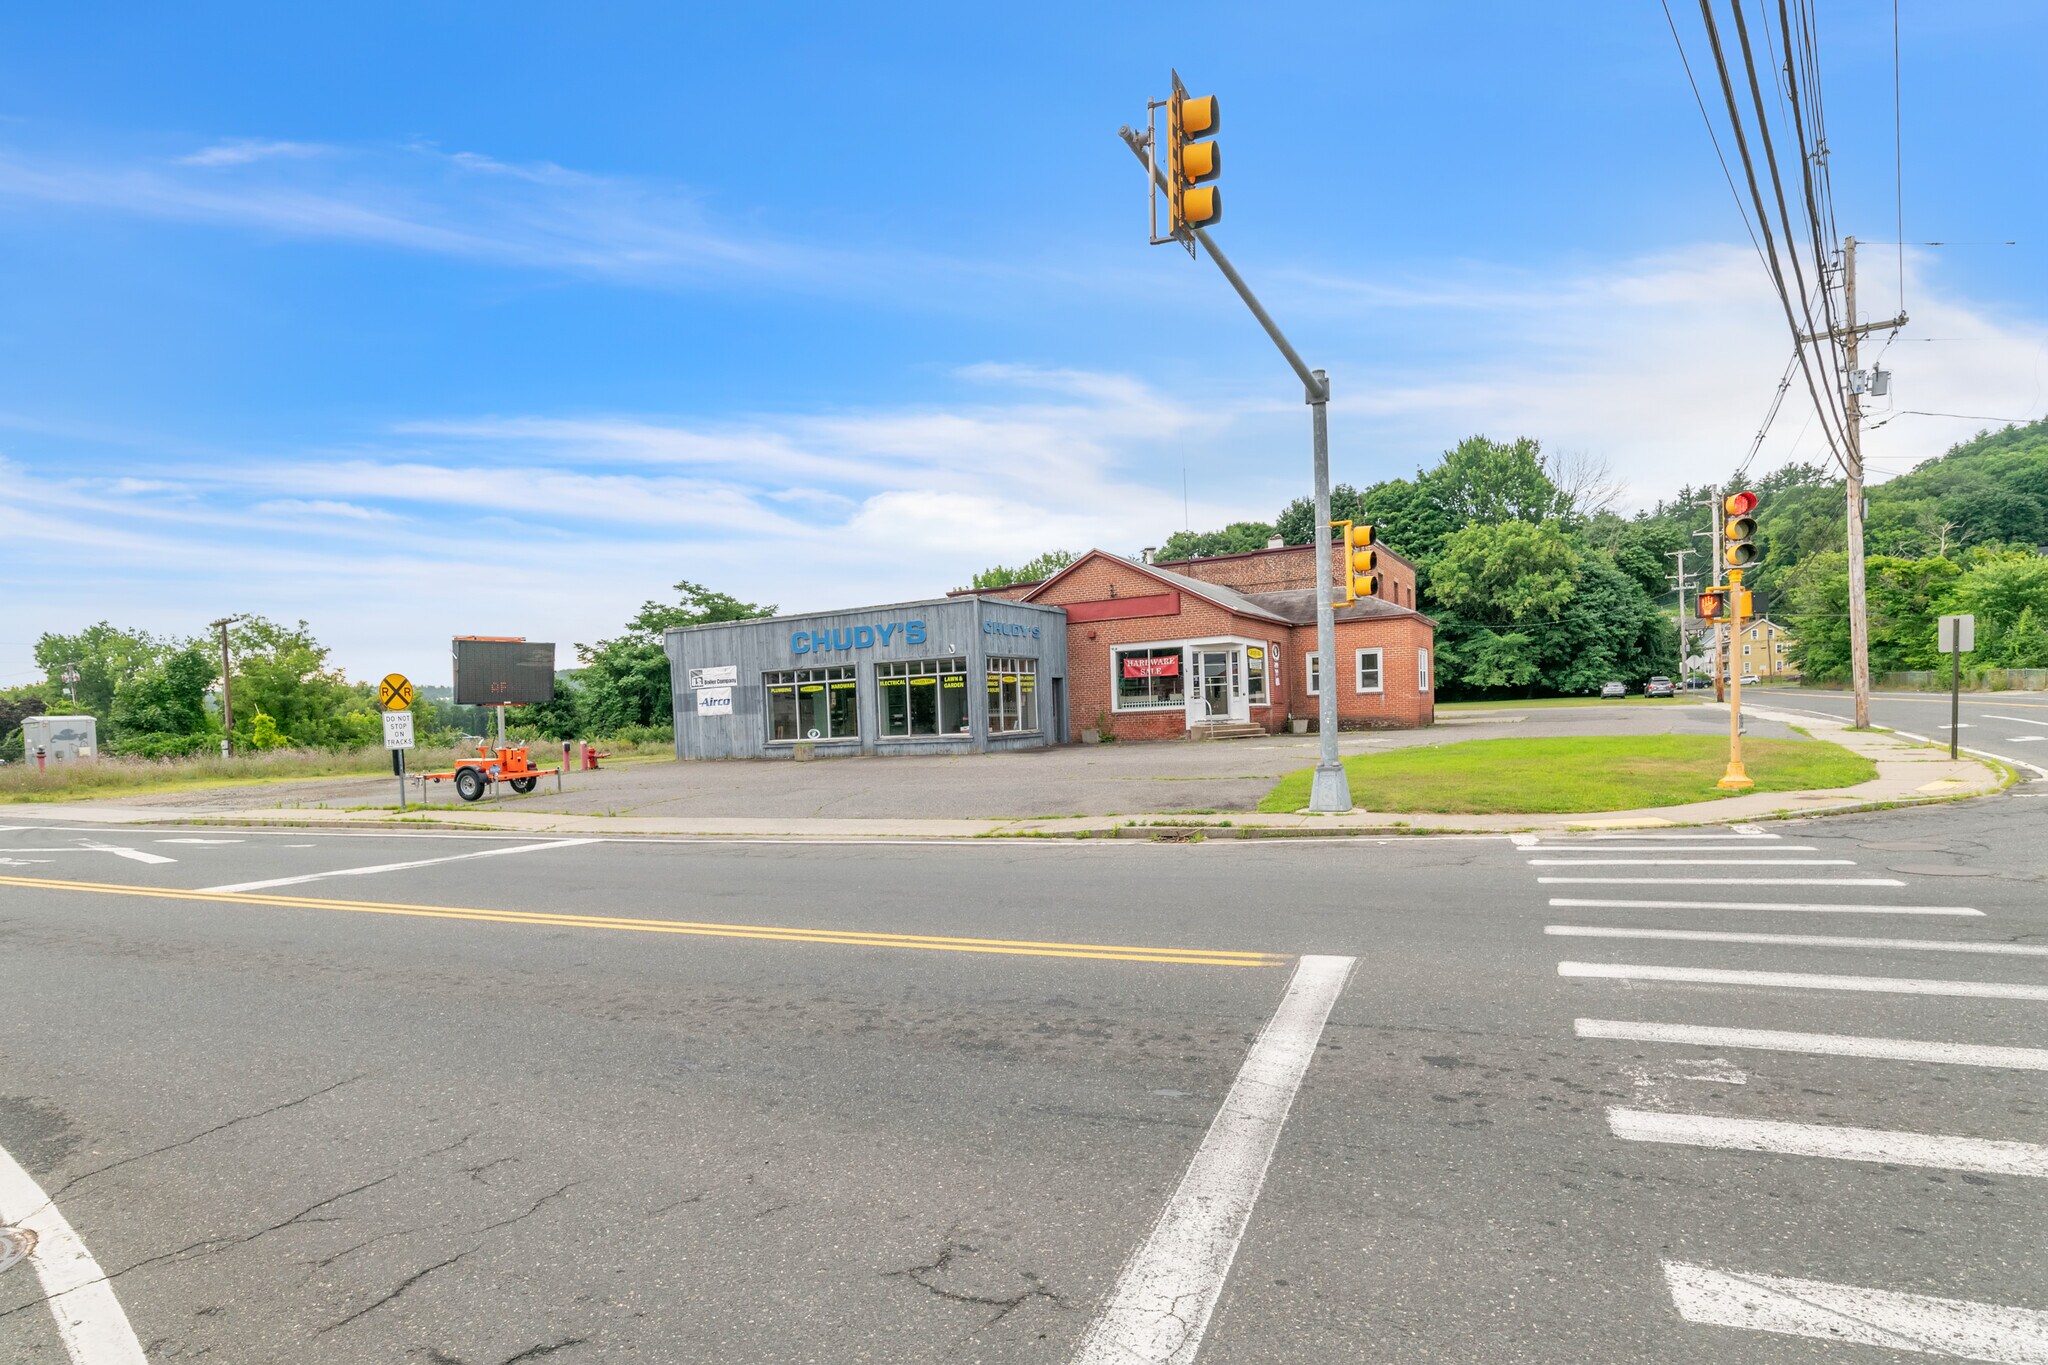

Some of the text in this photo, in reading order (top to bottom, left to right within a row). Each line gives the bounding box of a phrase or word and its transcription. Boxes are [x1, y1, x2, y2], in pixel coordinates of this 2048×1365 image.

[983, 620, 1041, 639] CHUDY'S
[791, 620, 927, 655] CHUDY'S
[382, 687, 389, 697] R
[701, 697, 731, 707] Airco
[386, 715, 396, 723] DO
[387, 738, 413, 746] TRACKS
